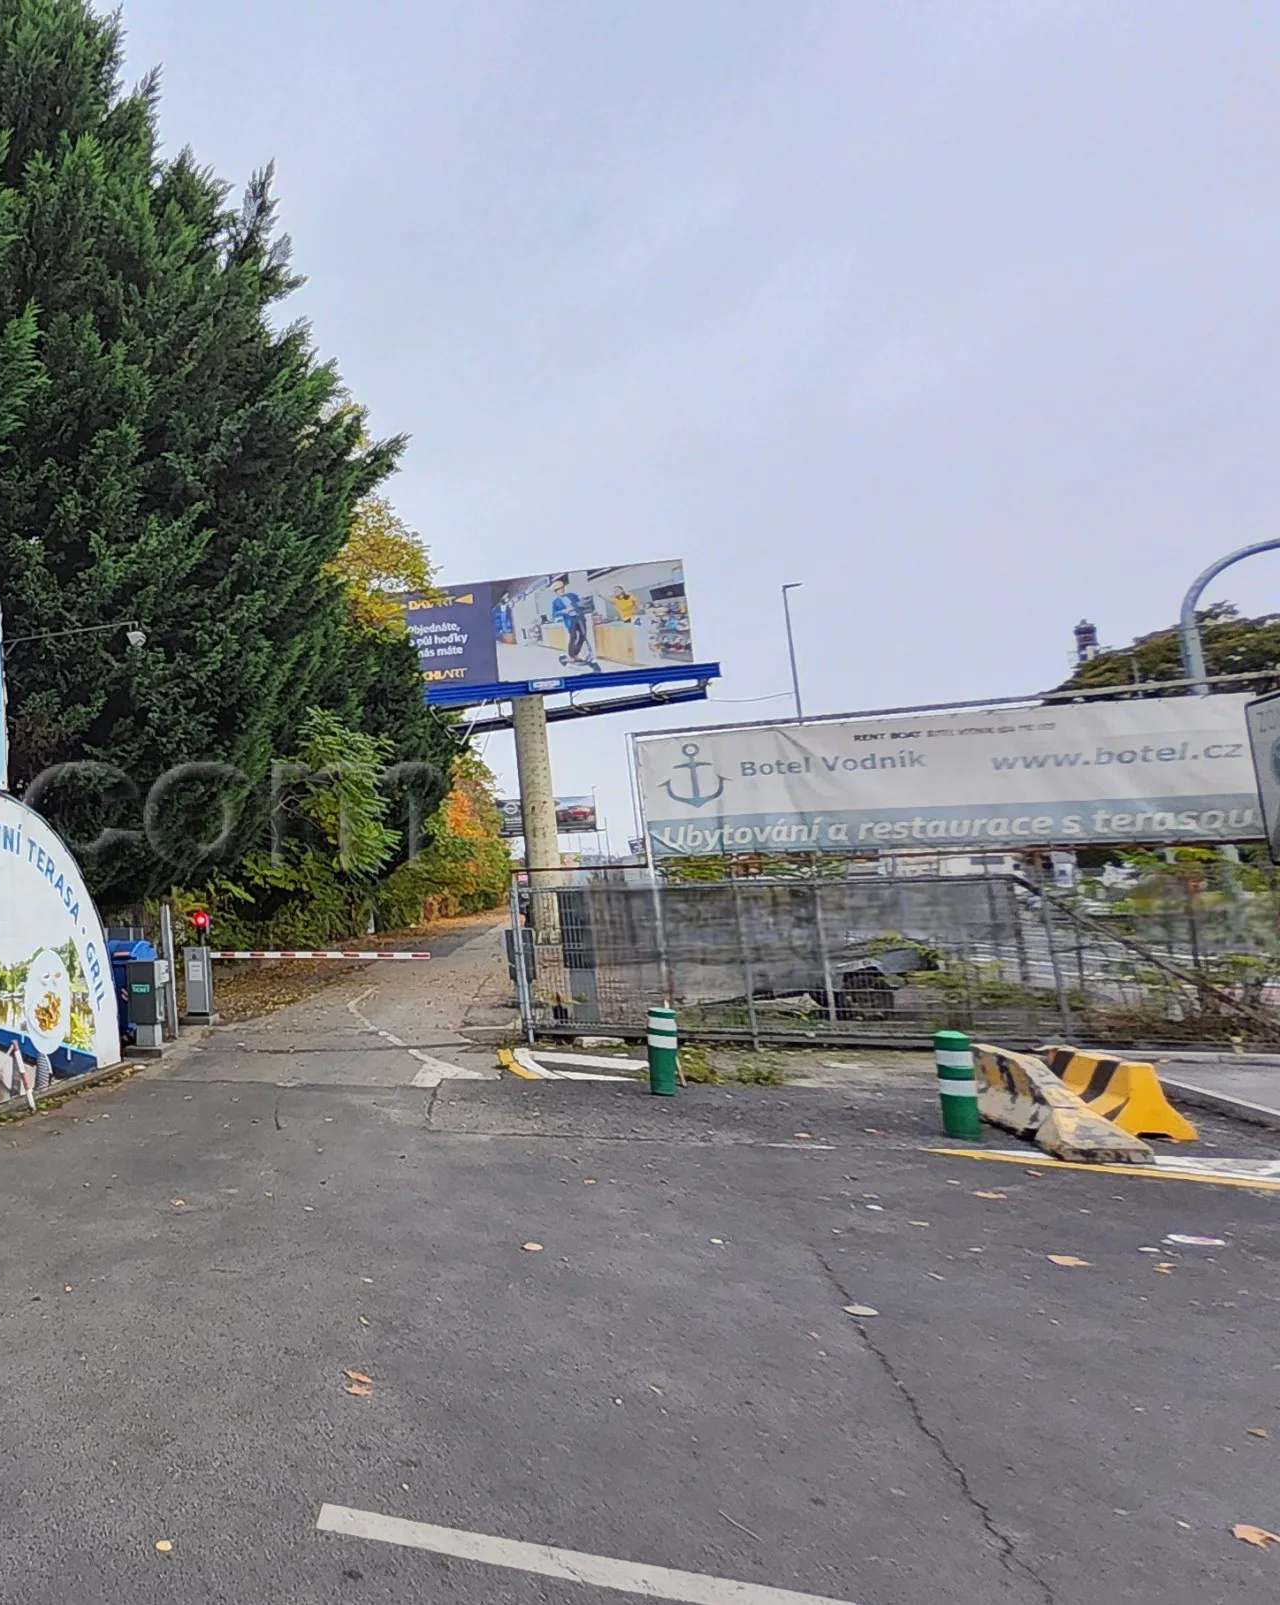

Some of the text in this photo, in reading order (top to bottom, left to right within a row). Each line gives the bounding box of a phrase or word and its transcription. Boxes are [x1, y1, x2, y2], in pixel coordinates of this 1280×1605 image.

[739, 740, 1243, 777] Botel Vodník www.botel.cz
[662, 805, 1256, 852] Ubytování a restaurace s terasou
[26, 835, 81, 926] TERASA
[84, 941, 104, 1012] GRIL
